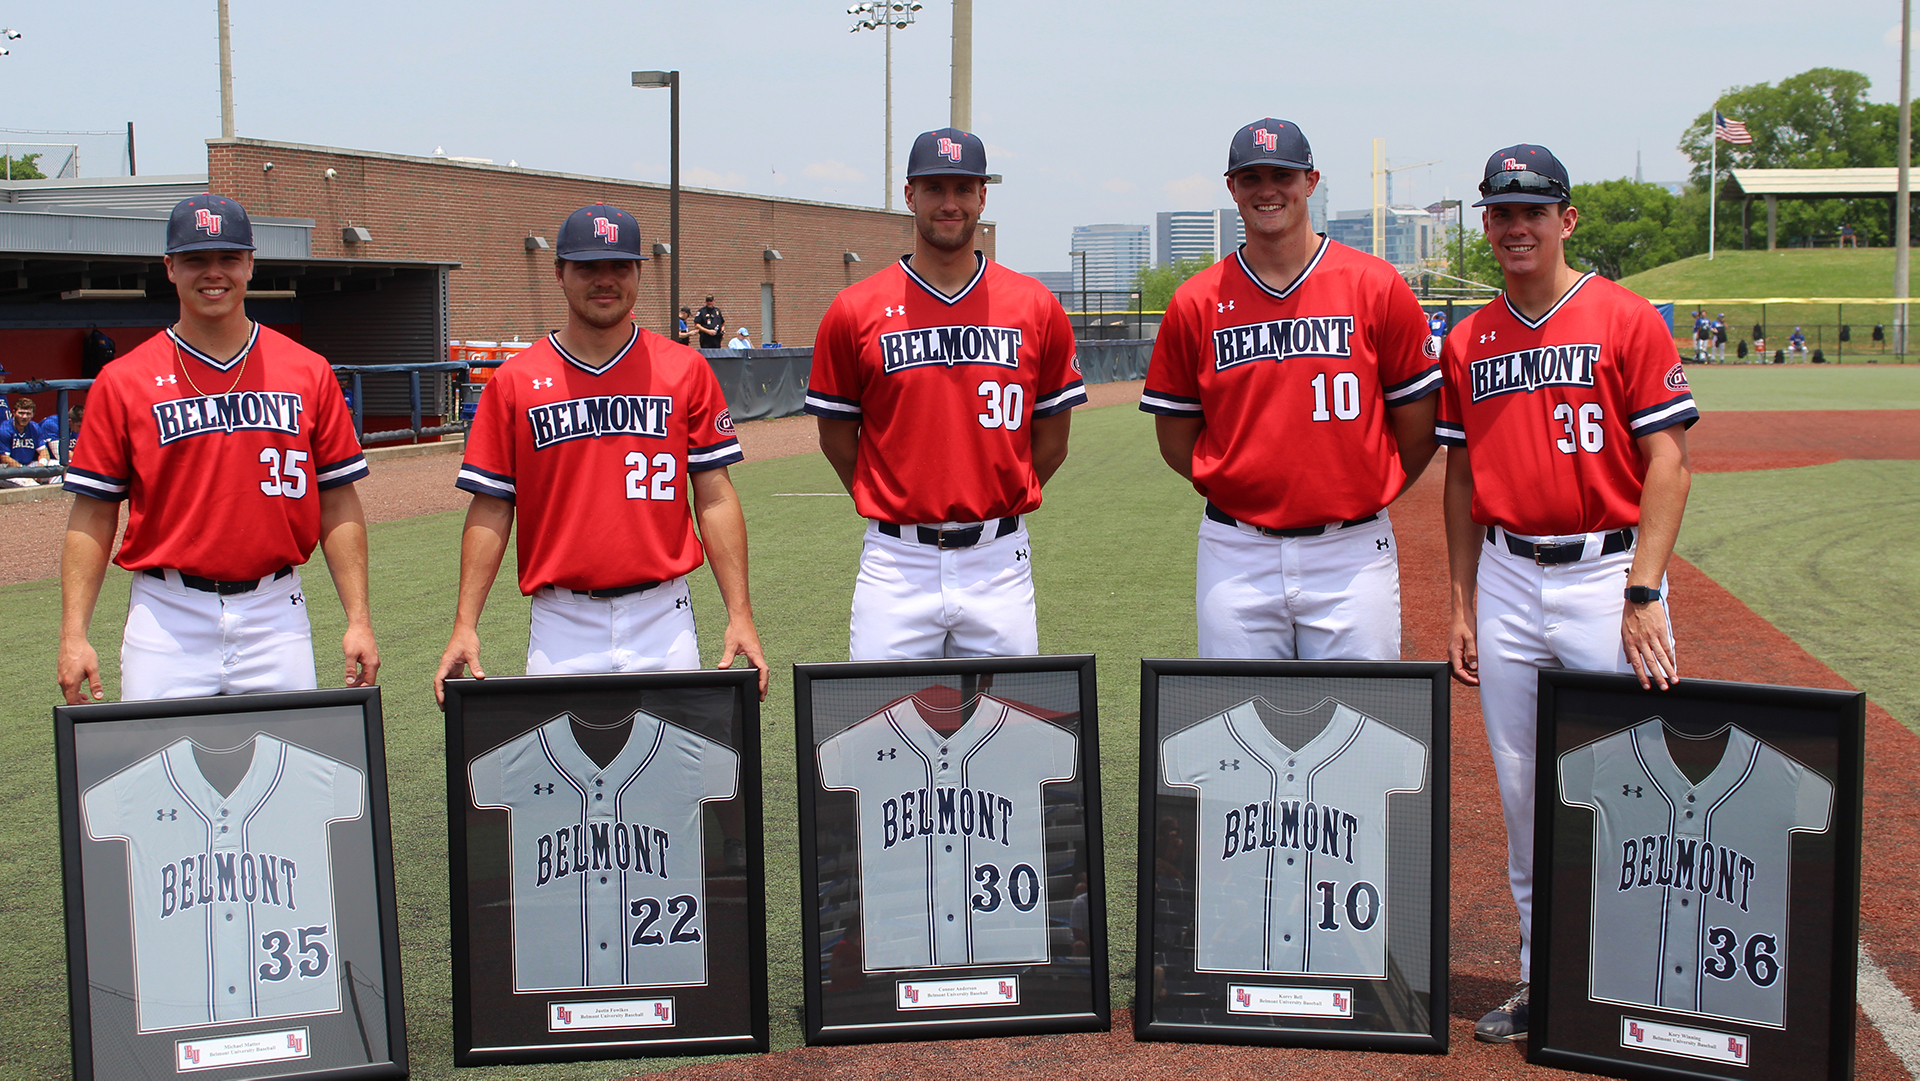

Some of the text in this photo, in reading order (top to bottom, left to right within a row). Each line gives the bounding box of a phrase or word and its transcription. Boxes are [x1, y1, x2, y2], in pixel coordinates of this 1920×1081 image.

[937, 137, 963, 163] BU
[1253, 128, 1277, 153] BU
[195, 208, 222, 237] BU
[593, 217, 619, 245] BU
[881, 326, 1022, 373] BELMONT
[1214, 316, 1354, 370] BELMONT
[1311, 372, 1361, 422] 10
[1471, 344, 1601, 401] BELMONT
[155, 392, 303, 445] BELMONT
[530, 396, 672, 448] BELMONT
[977, 380, 1024, 431] 30
[1553, 402, 1605, 454] 36
[259, 447, 308, 499] 35
[624, 451, 676, 501] 22
[882, 787, 1013, 850] BELMONT
[1222, 800, 1358, 865] BELMONT
[535, 821, 670, 888] BELMONT
[1617, 834, 1756, 913] BELMONT
[159, 850, 298, 921] BELMONT
[970, 862, 1043, 914] 30
[1316, 880, 1384, 932] 10
[629, 894, 702, 948] 22
[257, 922, 333, 984] 35
[1703, 925, 1783, 989] 36
[654, 1002, 669, 1021] BU
[904, 985, 919, 1003] BU
[998, 981, 1013, 999] BU
[1237, 988, 1251, 1007] BU
[1333, 993, 1348, 1012] BU
[557, 1006, 572, 1025] BU
[1629, 1022, 1644, 1043] BU
[184, 1045, 200, 1064] BU
[230, 1047, 256, 1056] University
[256, 1045, 277, 1053] Baseball
[287, 1033, 303, 1053] BU
[1652, 1035, 1717, 1050] Belmont University Baseball
[1728, 1037, 1743, 1058] BU
